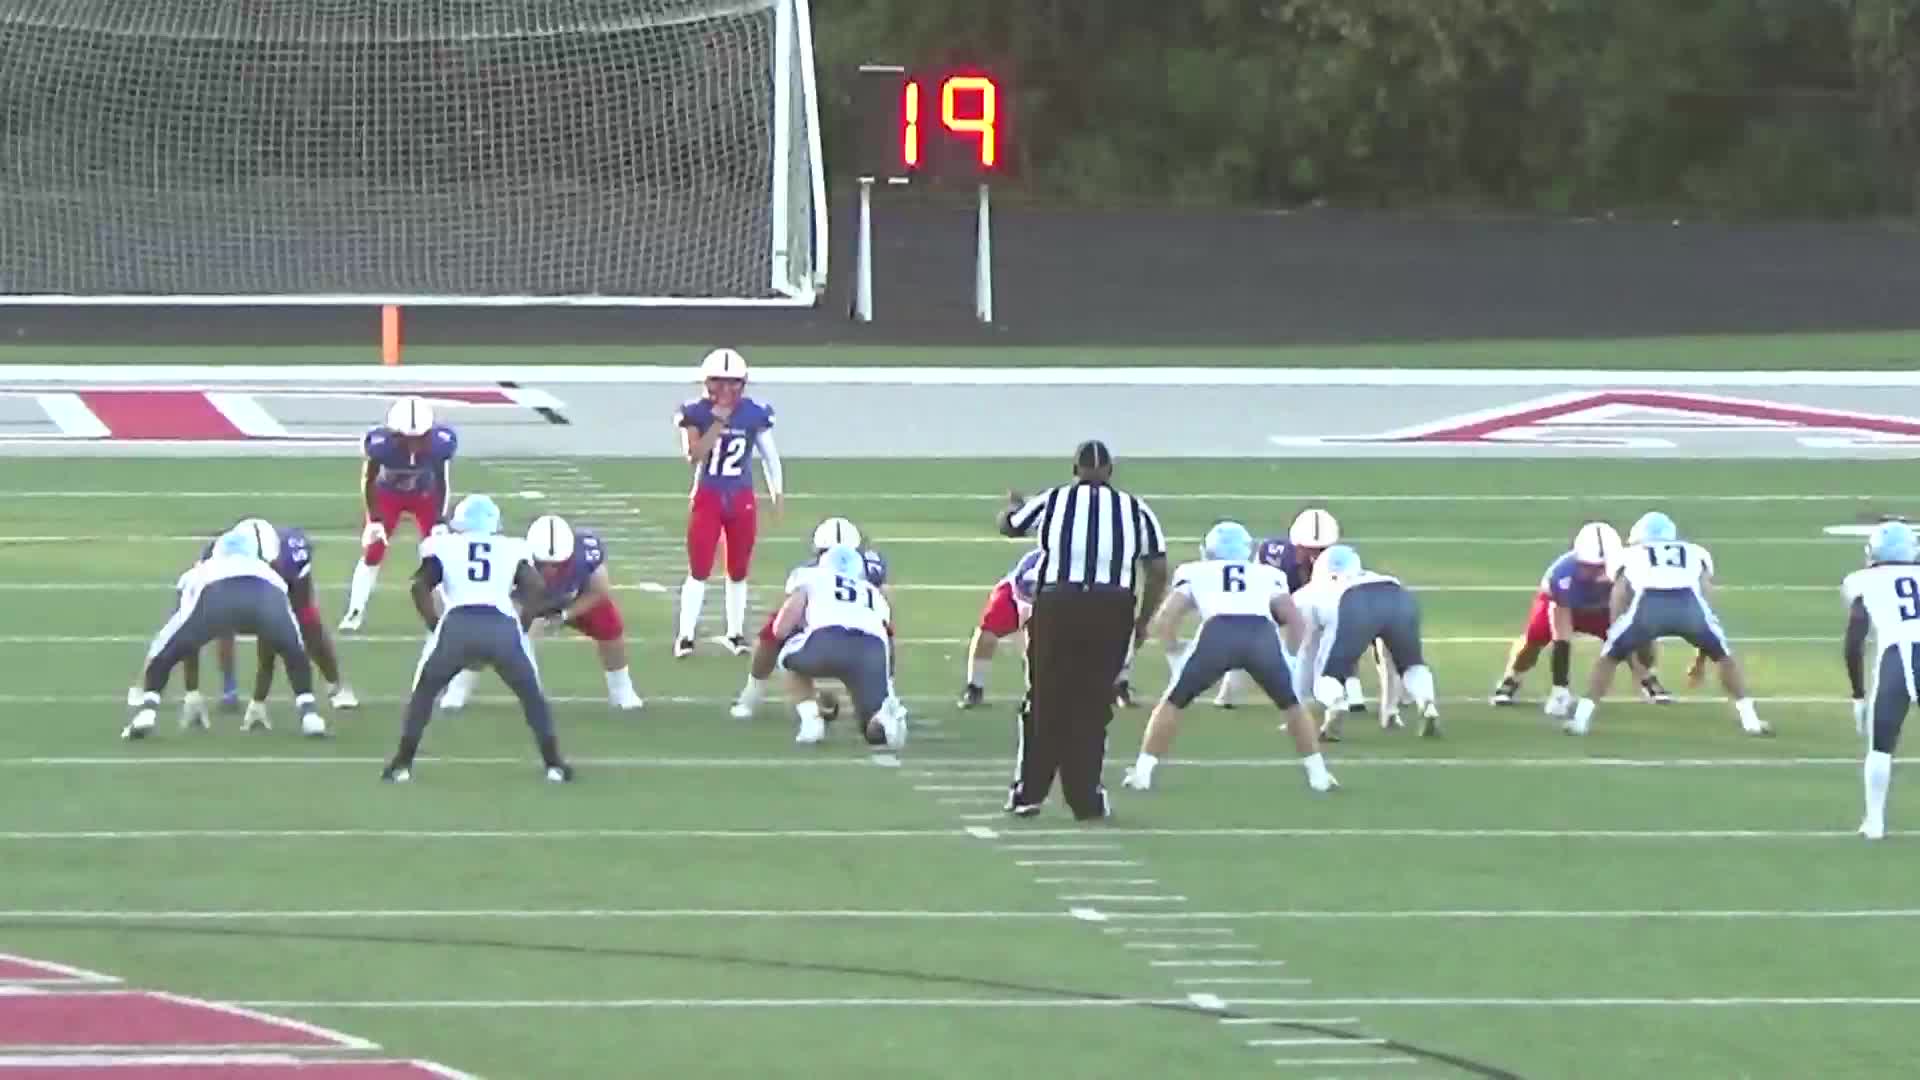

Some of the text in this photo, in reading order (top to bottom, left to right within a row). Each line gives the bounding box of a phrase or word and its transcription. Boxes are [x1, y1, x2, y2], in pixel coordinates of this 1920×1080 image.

[904, 76, 995, 166] 19
[708, 437, 746, 476] 12
[468, 542, 491, 582] 5
[1646, 544, 1686, 569] 13
[834, 575, 874, 611] 51
[1222, 564, 1246, 593] 6
[1894, 576, 1920, 621] 9
